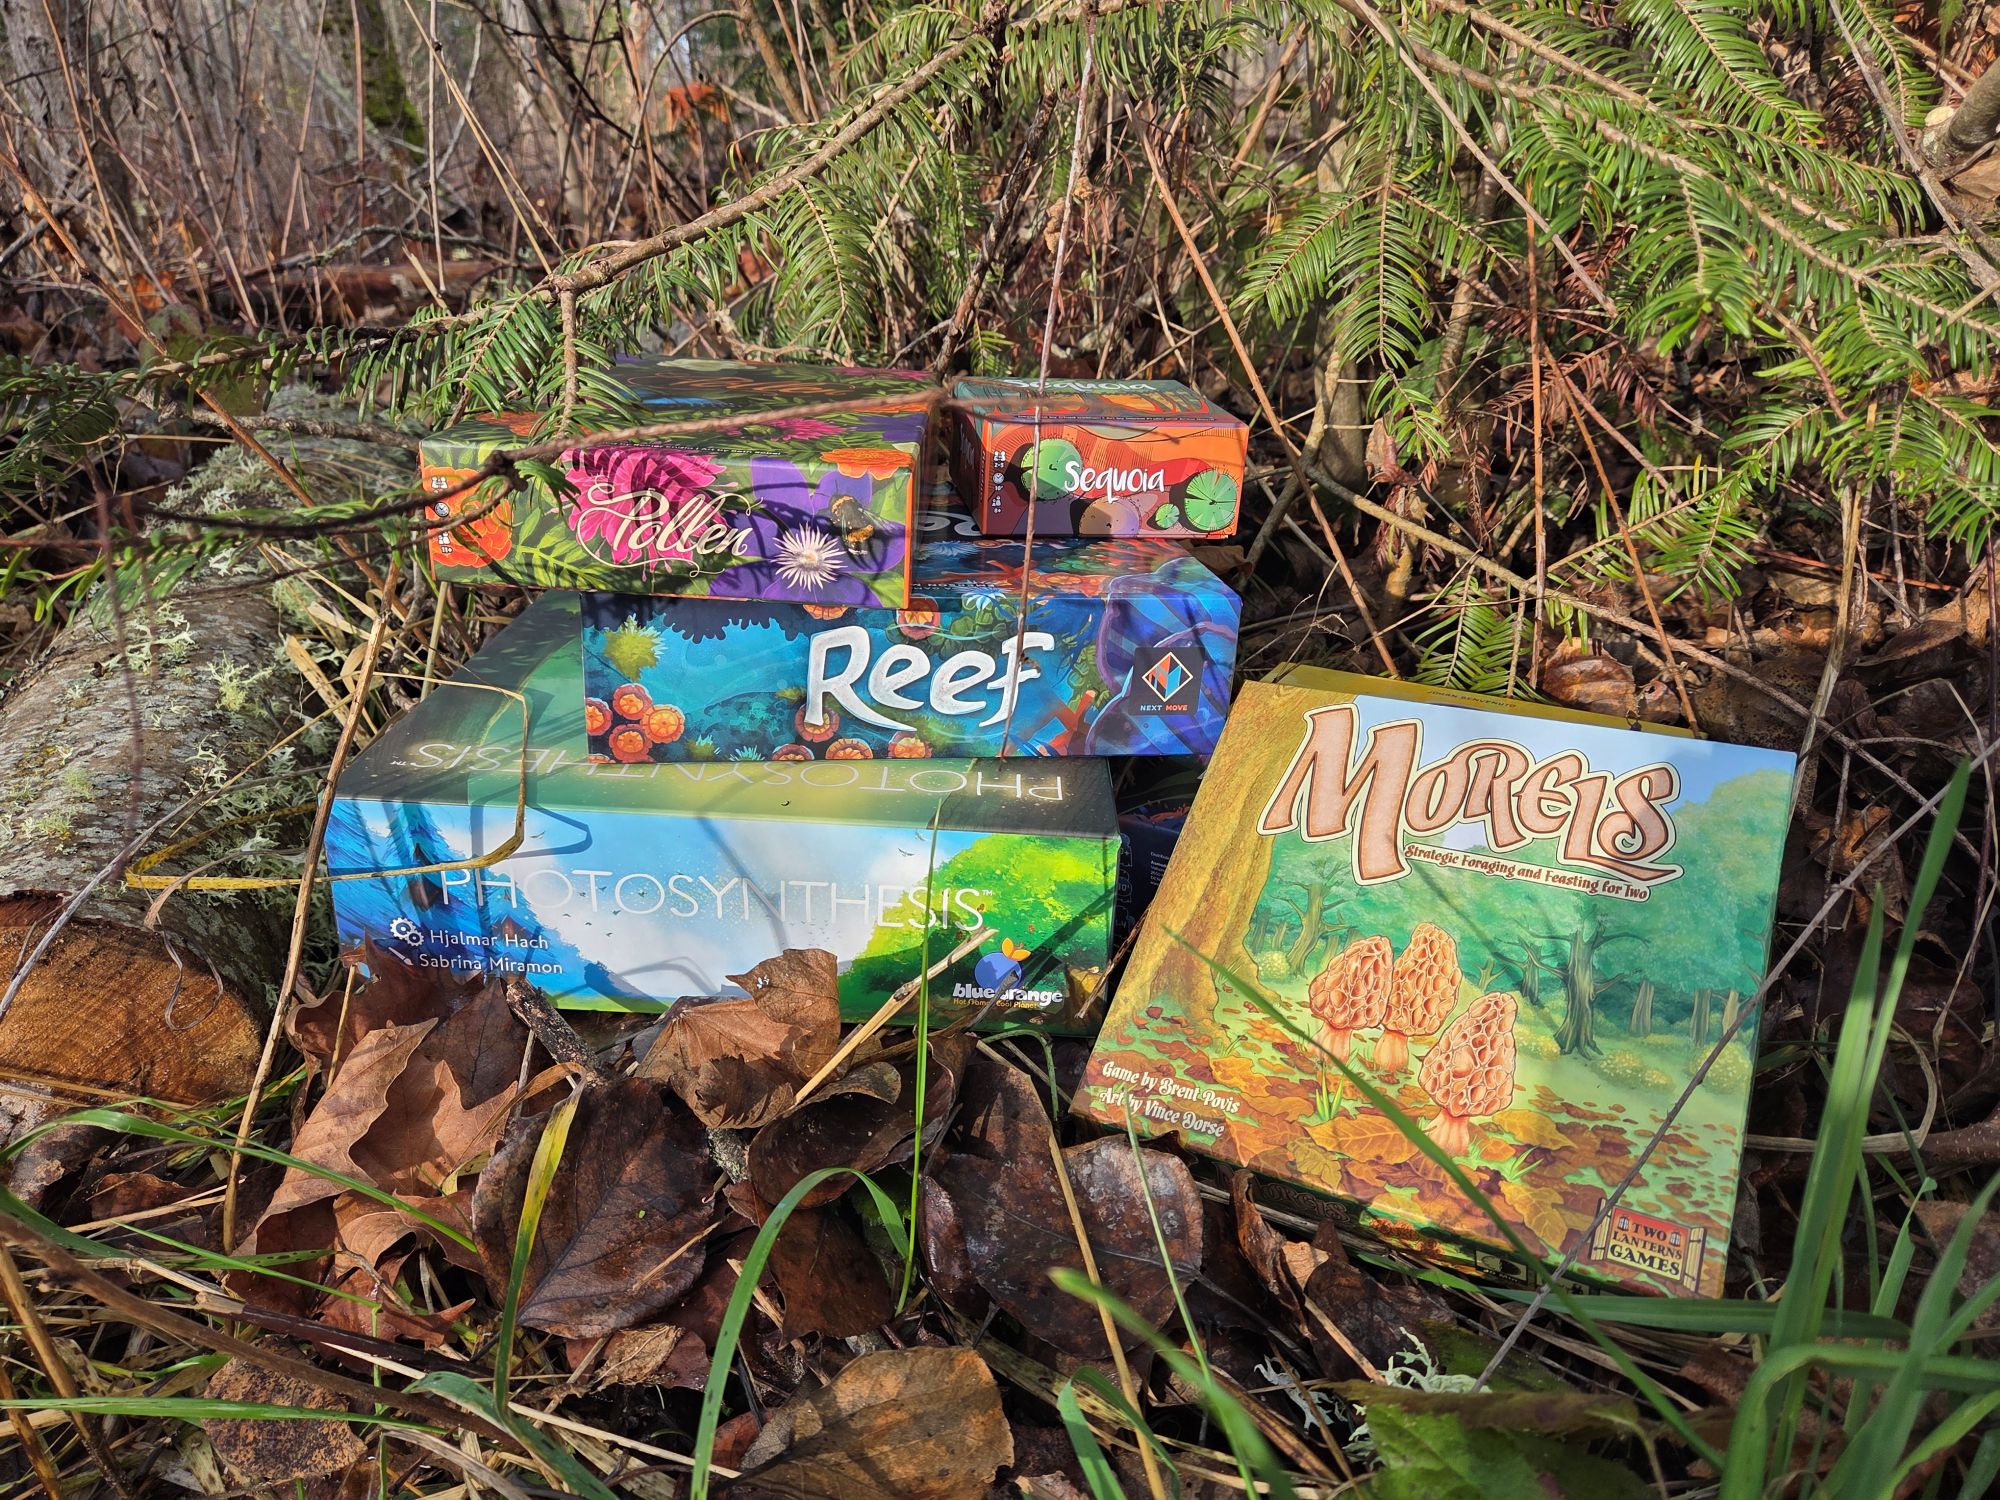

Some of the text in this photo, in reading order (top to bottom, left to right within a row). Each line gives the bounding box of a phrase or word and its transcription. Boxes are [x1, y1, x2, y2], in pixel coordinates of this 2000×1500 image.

[1003, 379, 1157, 392] Sequoia
[1064, 460, 1165, 504] Sequoia
[577, 476, 764, 577] Pollen
[804, 625, 1055, 732] Reef
[1404, 845, 1648, 900] Strategic Foraging and Feasting for Two
[440, 868, 984, 931] PHOTOSYNTHESIS
[430, 930, 549, 949] Hjalmar Hach
[420, 953, 563, 974] Sabrina Miramon
[1102, 1061, 1240, 1113] Game by Brent Povis
[1100, 1087, 1125, 1105] Art
[1144, 1099, 1180, 1123] Vince
[1182, 1111, 1225, 1137] Dorse
[1612, 1231, 1682, 1260] LANTERNS
[1632, 1223, 1667, 1241] TWO
[1610, 1244, 1680, 1275] GAMES
